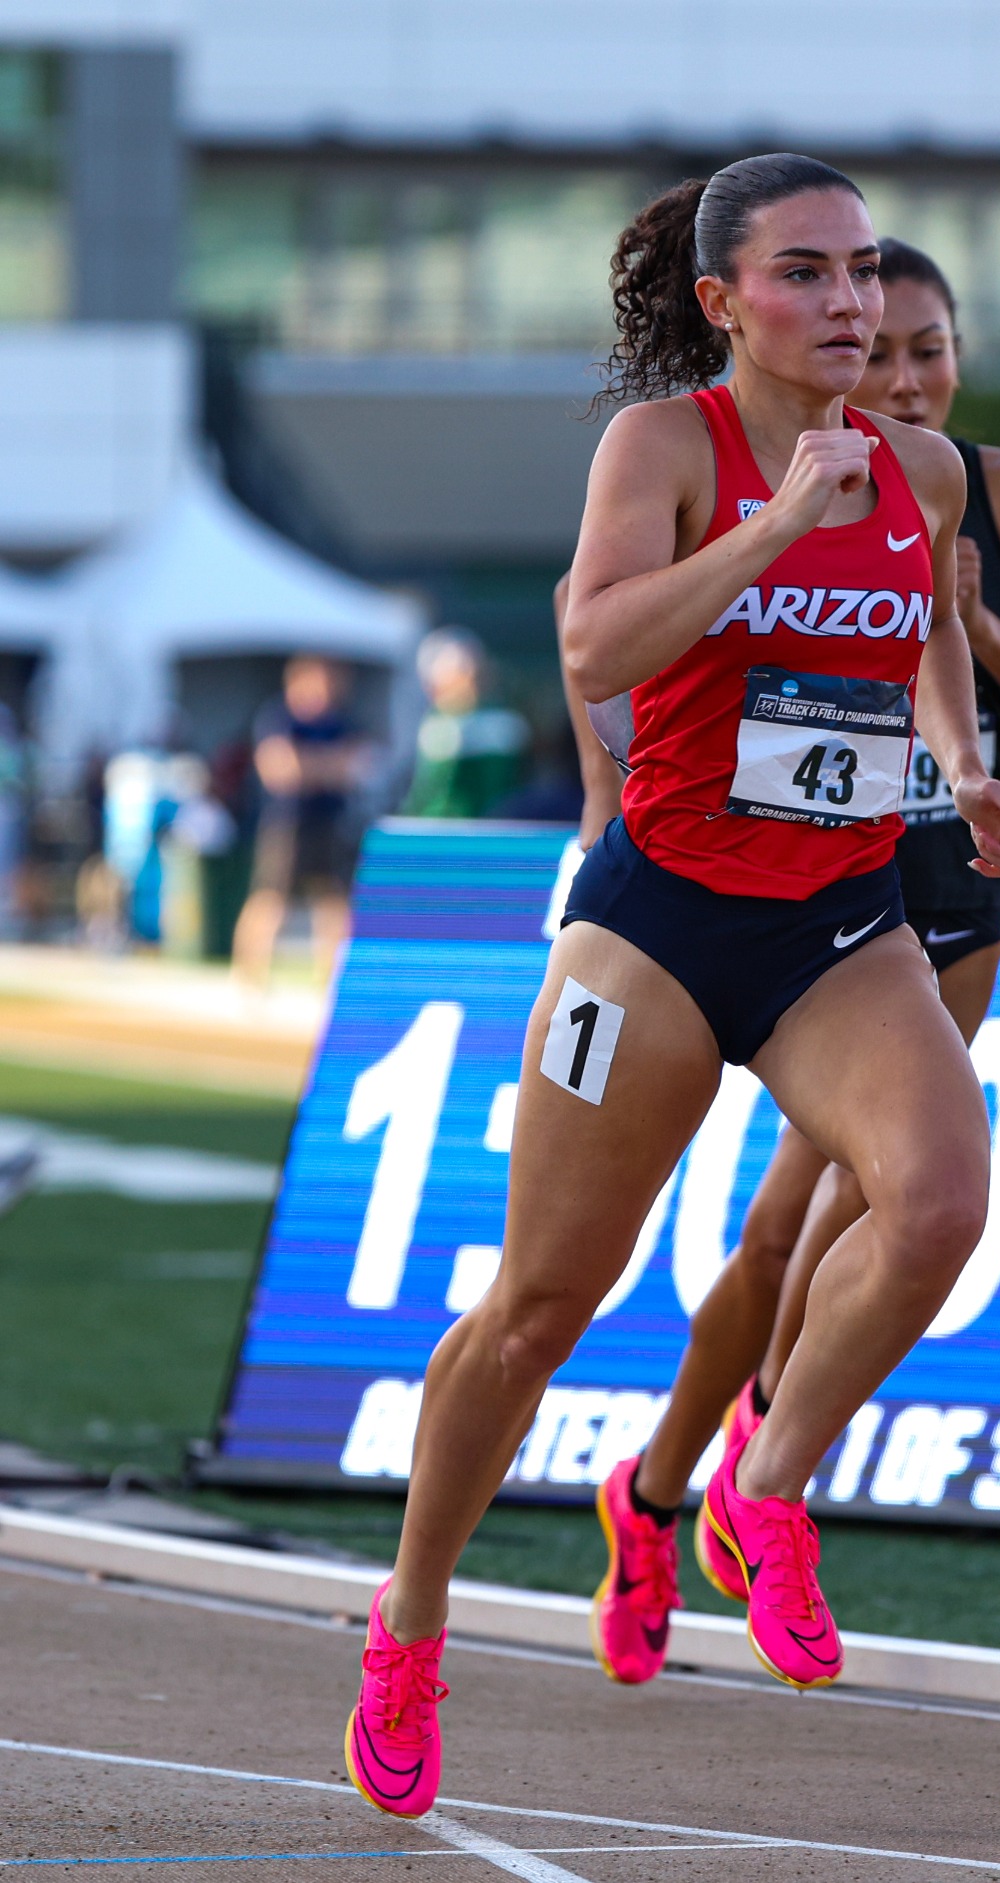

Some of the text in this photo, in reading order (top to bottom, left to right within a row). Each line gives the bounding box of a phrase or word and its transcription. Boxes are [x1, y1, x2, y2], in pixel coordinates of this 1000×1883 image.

[778, 702, 907, 728] TRACK & FIELD CHAMPIONSHIPS
[792, 745, 858, 806] 43
[811, 816, 825, 827] CA
[567, 1001, 600, 1091] 1
[870, 1403, 988, 1506] OF
